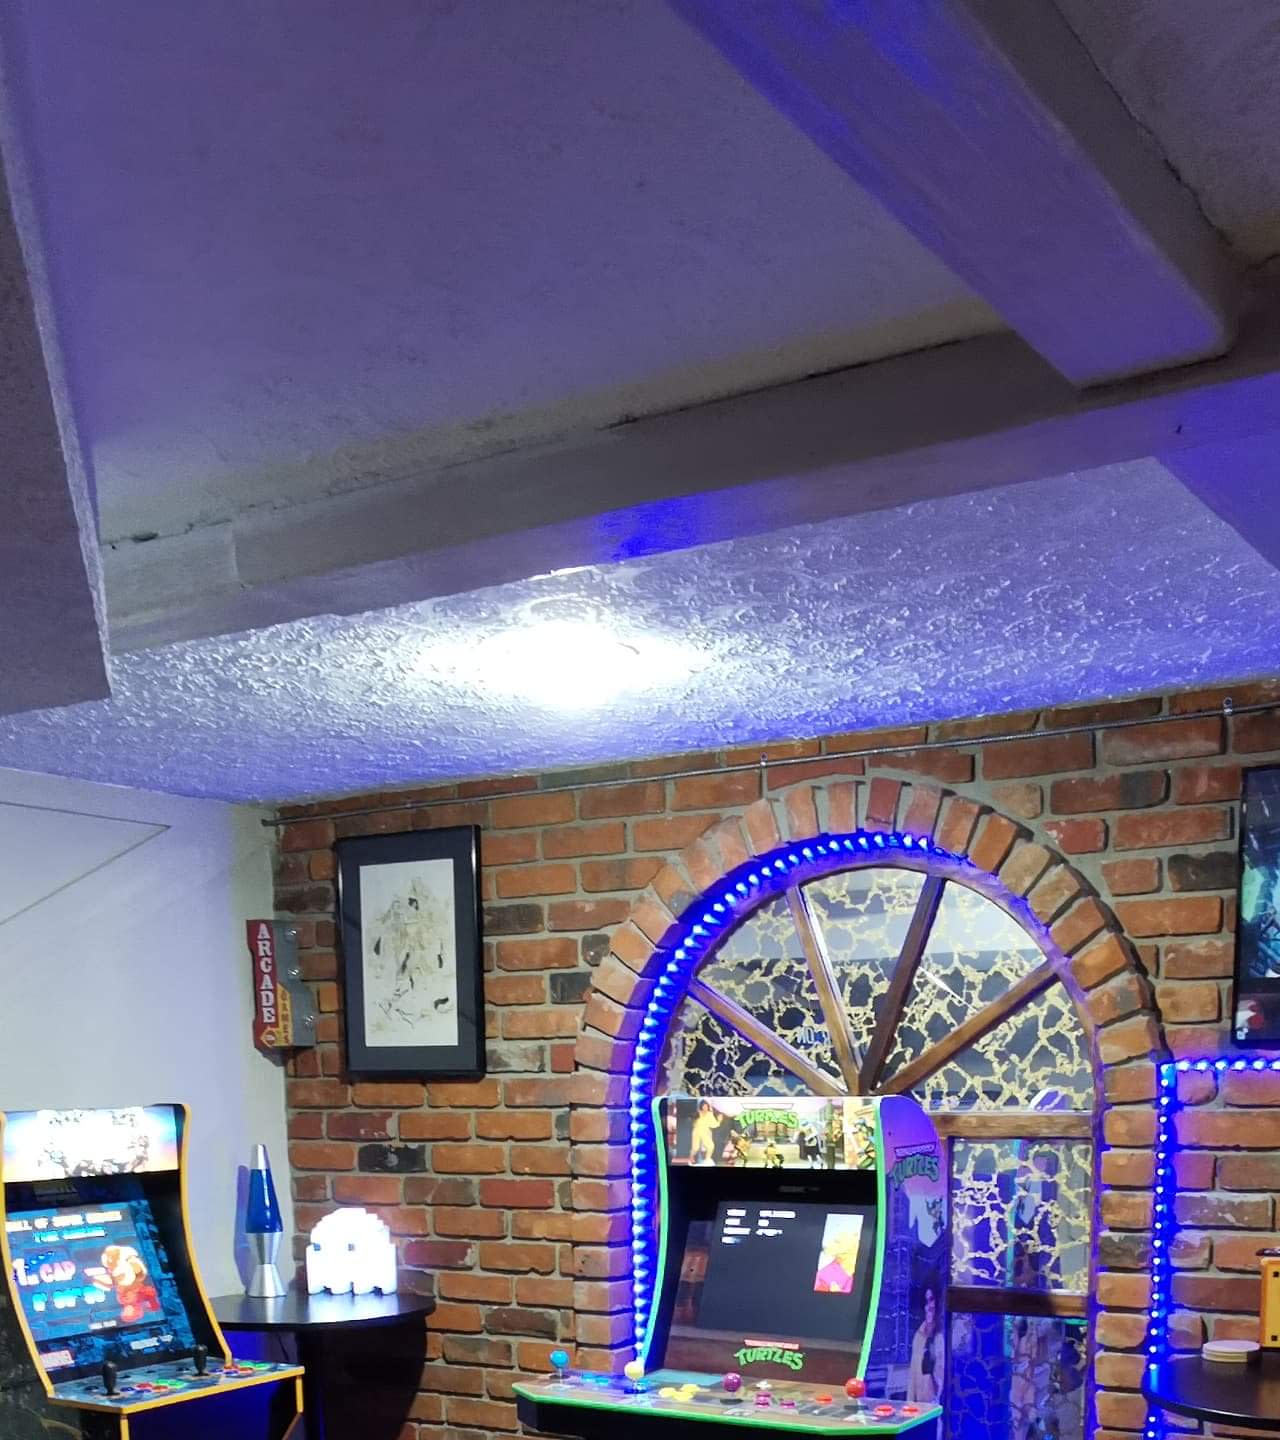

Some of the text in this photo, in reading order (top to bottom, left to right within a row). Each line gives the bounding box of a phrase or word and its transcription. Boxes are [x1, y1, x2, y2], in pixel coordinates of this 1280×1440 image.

[257, 922, 276, 1023] ARCADE
[735, 1108, 799, 1129] TURTLES
[887, 1153, 939, 1186] TURTLES
[733, 1347, 803, 1370] TURTLES
